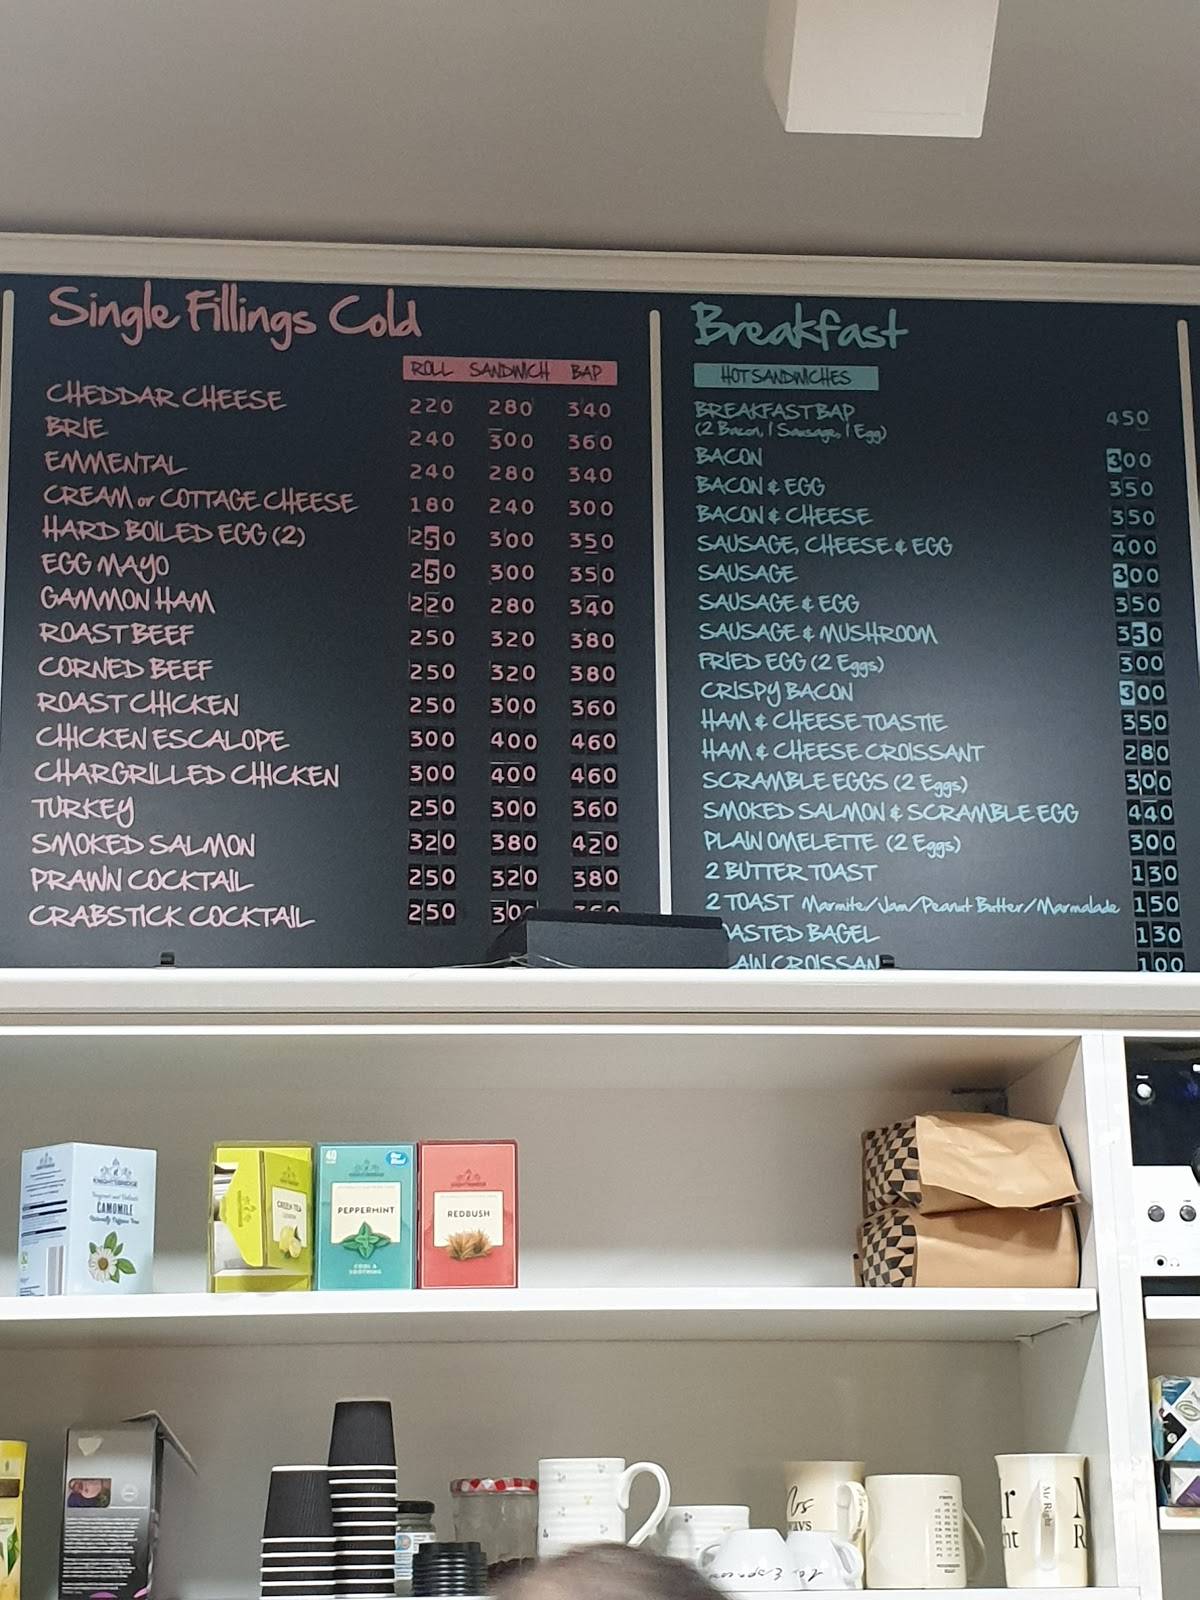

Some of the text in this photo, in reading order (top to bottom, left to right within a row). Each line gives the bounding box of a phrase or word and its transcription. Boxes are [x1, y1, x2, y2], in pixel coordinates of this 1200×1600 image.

[48, 280, 422, 351] Single Fillings Cold
[691, 301, 909, 351] Breakfast
[411, 361, 602, 381] ROLL SANDWICH BAP
[720, 365, 852, 387] HOT SANDWICHES
[47, 380, 287, 412] CHEDDAR CHEESE
[410, 398, 452, 414] 220
[489, 400, 532, 416] 280
[568, 402, 610, 418] 340
[694, 401, 856, 422] BREAKFAST BAP
[45, 415, 108, 439] BRIE
[1106, 410, 1149, 426] 450
[695, 421, 714, 436] (2
[854, 423, 887, 444] Egg)
[44, 450, 188, 476] EMMENTAL
[695, 447, 763, 467] BACON
[1107, 452, 1151, 469] 300
[695, 475, 826, 496] BACON EGG
[1109, 480, 1153, 498] 350
[43, 484, 359, 514] CREAM or COTTAGE CHEESE
[410, 497, 454, 512] 180
[490, 498, 534, 515] 240
[569, 500, 613, 516] 300
[696, 504, 873, 527] BACON CHEESE
[1111, 510, 1155, 526] 350
[43, 515, 306, 547] HARD BOILED EGG (2)
[805, 534, 892, 556] CHEESE
[912, 536, 953, 556] EGG
[1112, 539, 1157, 556] 400
[41, 552, 93, 576] EGG
[410, 562, 456, 582] 250
[490, 564, 534, 581] 300
[698, 563, 799, 583] SAUSAGE
[570, 566, 614, 582] 350
[1114, 567, 1160, 584] 300
[41, 586, 216, 614] GAMMON HAM
[699, 592, 860, 614] SAUSAGE EGG
[1115, 596, 1161, 613] 350
[39, 622, 195, 646] ROAST BEEF
[410, 630, 455, 646] 250
[490, 631, 534, 648] 320
[571, 632, 614, 649] 380
[699, 621, 938, 646] SAUSAGE MUSHROOM
[1117, 626, 1163, 644] 350
[38, 657, 214, 681] CORNED BEEF
[698, 652, 885, 678] FRIED EGG (2 Eggs)
[1120, 656, 1163, 673] 300
[701, 682, 854, 707] CRISPY BACON
[1121, 685, 1165, 700] 300
[37, 690, 240, 717] ROAST CHICKEN
[410, 697, 455, 714] 250
[491, 698, 536, 715] 300
[571, 699, 616, 716] 360
[701, 708, 949, 734] HAM CHEESE TOASTIE
[1123, 714, 1167, 730] 350
[35, 724, 290, 753] CHICKEN ESCALOPE
[701, 739, 986, 763] HAM CHEESE CROISSANT
[1124, 745, 1169, 761] 280
[34, 759, 340, 788] CHARGRILLED CHICKEN
[410, 764, 455, 782] 300
[491, 765, 536, 783] 400
[572, 767, 616, 784] 460
[702, 772, 968, 798] SCRAMBLE EGGS (2 Eggs)
[1126, 774, 1171, 792] 300
[32, 796, 135, 828] TURKEY
[703, 802, 1079, 824] SMOKED SALMON SCRAMBLE EGG
[1128, 804, 1173, 823] 440
[31, 832, 255, 857] SMOKED SALMON
[410, 833, 455, 851] 320
[492, 834, 537, 851] 380
[573, 835, 618, 854] 420
[704, 831, 961, 859] PLAIN OMELETTE (2 Eggs)
[1130, 834, 1176, 851] 300
[30, 866, 255, 892] PRAWN COCKTAIL
[409, 868, 455, 886] 250
[492, 869, 537, 887] 320
[573, 870, 618, 887] 380
[705, 861, 878, 883] 2 BUTTER TOAST
[1134, 865, 1177, 883] 130
[409, 902, 455, 921] 250
[705, 893, 720, 911] 2
[724, 893, 795, 912] TOAST
[1135, 896, 1179, 912] 150
[29, 904, 315, 928] CRABSTICK COCKTAIL
[806, 923, 880, 944] BAGEL
[1137, 926, 1181, 944] 130
[1139, 957, 1184, 972] 100
[337, 1206, 396, 1215] PEPPERMINT
[447, 1209, 491, 1218] REDBUSH
